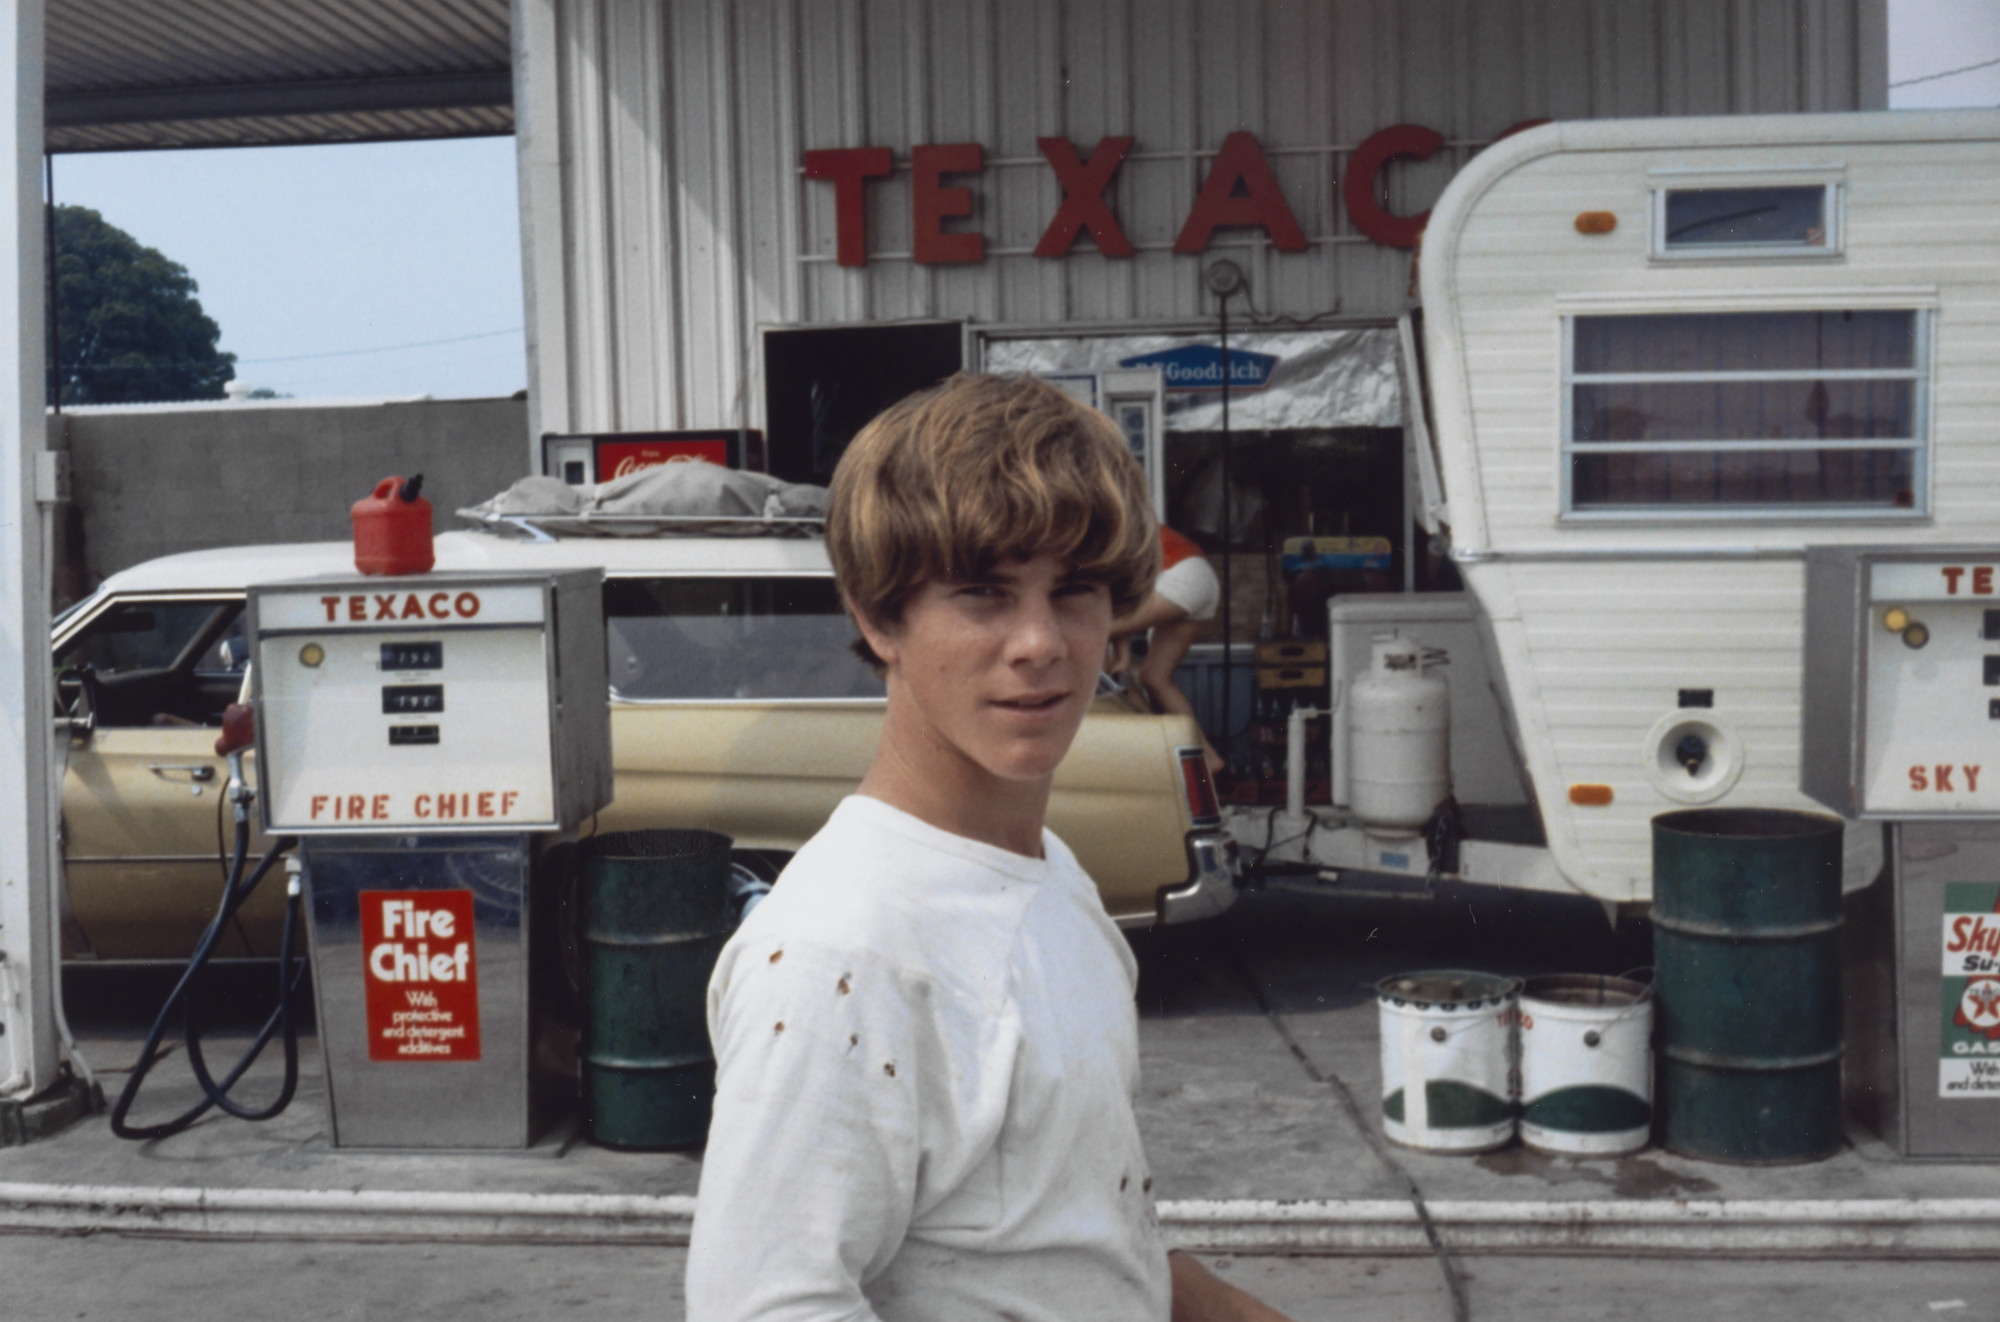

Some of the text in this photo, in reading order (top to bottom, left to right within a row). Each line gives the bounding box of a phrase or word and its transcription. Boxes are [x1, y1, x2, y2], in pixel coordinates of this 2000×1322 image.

[804, 119, 1545, 268] TEXAC
[320, 591, 481, 622] TEXACO
[1908, 765, 1981, 793] SKY
[310, 791, 519, 820] FIRE CHIEF
[382, 899, 456, 939] Fire
[369, 942, 469, 983] Chief
[404, 989, 438, 1007] With
[392, 1009, 454, 1025] protective
[382, 1024, 465, 1042] and detergent
[398, 1038, 452, 1055] additives
